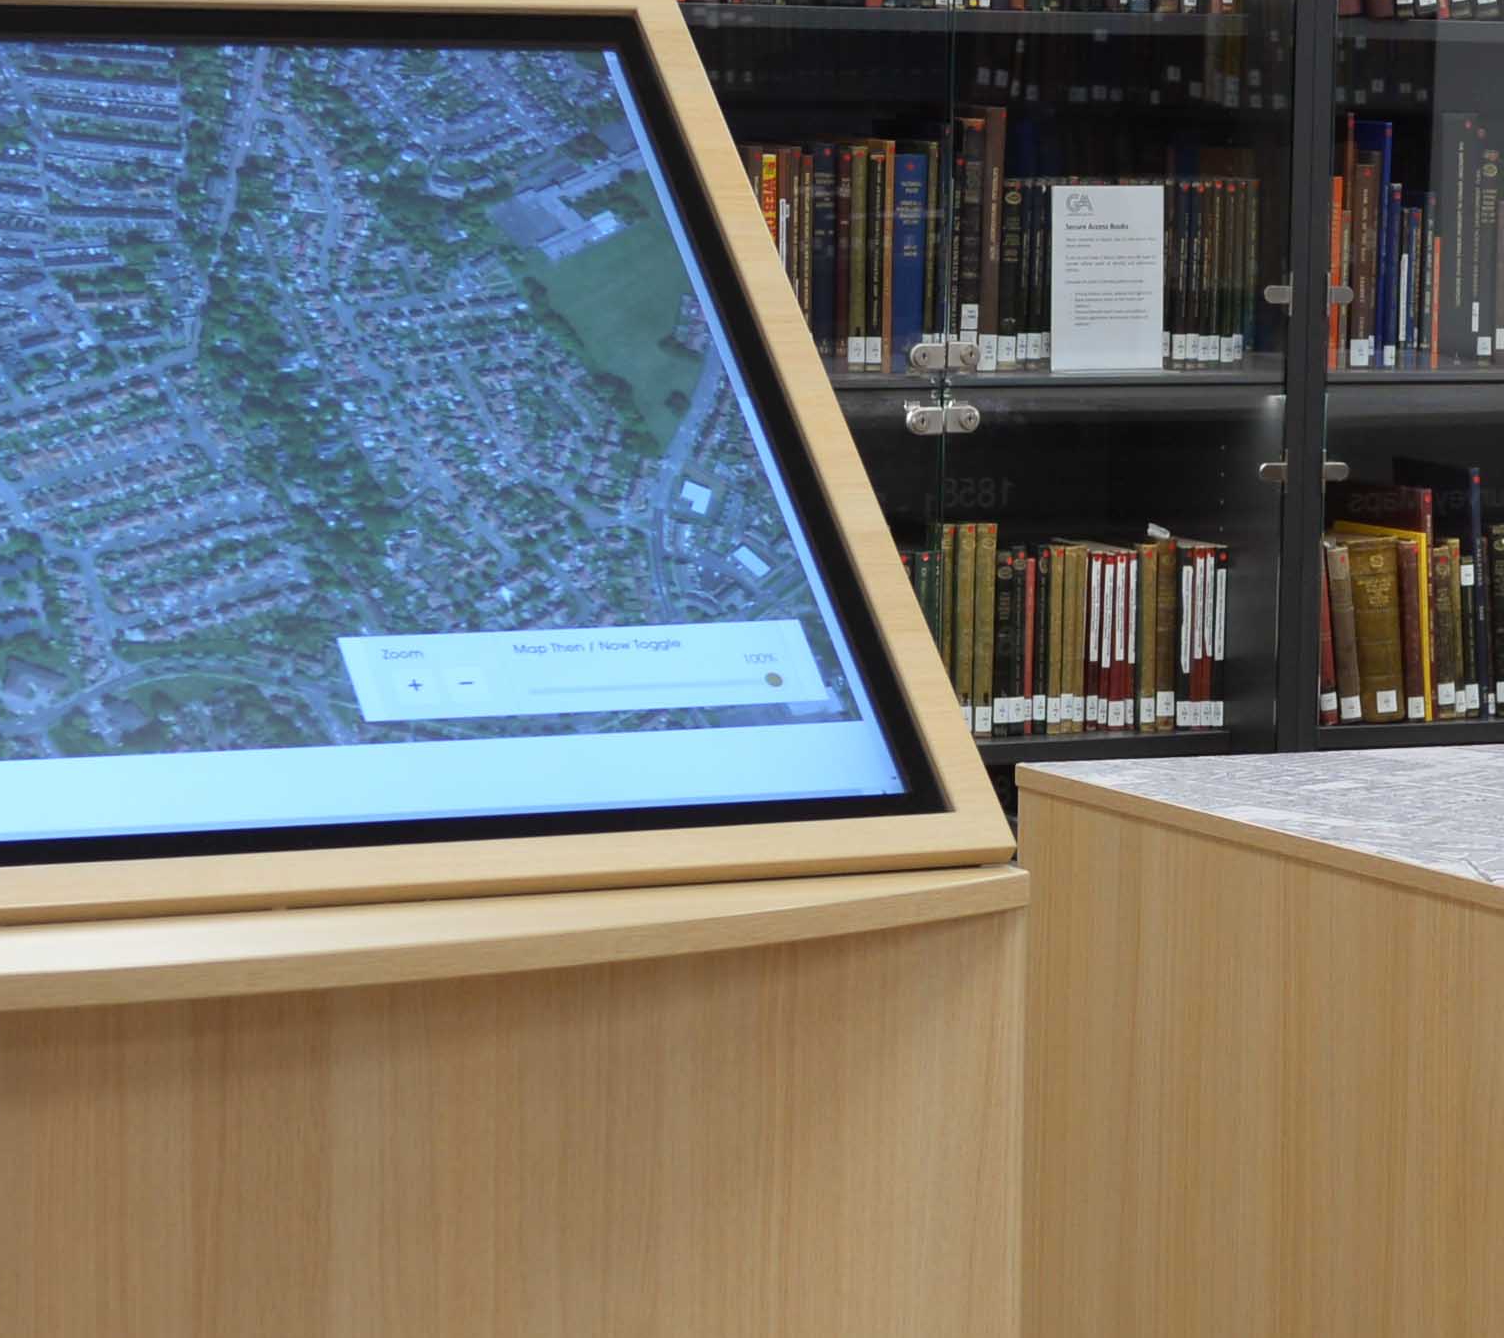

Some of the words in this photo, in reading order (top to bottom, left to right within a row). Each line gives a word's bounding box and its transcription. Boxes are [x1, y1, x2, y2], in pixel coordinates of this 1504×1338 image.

[381, 648, 425, 661] Zoom
[513, 642, 547, 656] Map
[549, 640, 585, 654] Then
